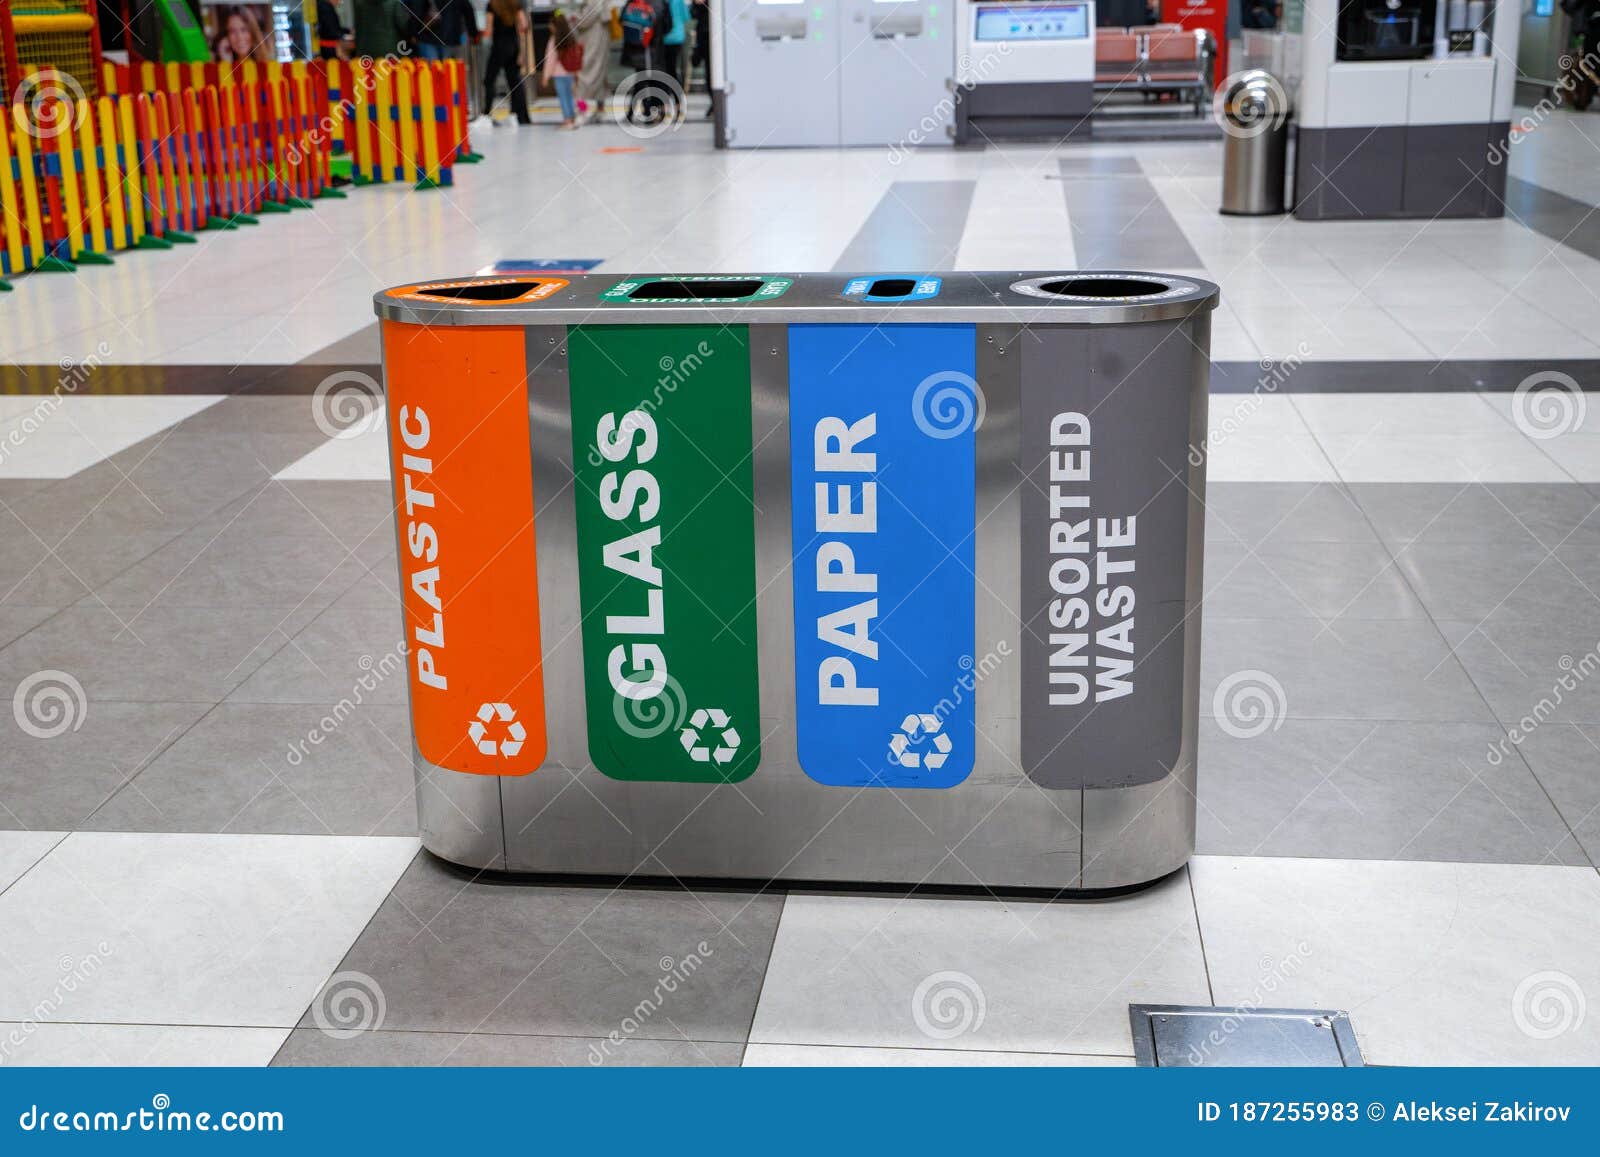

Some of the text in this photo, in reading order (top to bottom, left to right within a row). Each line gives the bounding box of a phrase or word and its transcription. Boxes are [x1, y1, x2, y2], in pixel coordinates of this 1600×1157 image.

[400, 404, 448, 690] PLASTIC
[597, 409, 668, 700] GLASS
[814, 412, 879, 706] PAPER
[1049, 411, 1091, 705] UNSORTED
[1096, 515, 1137, 703] WASTE
